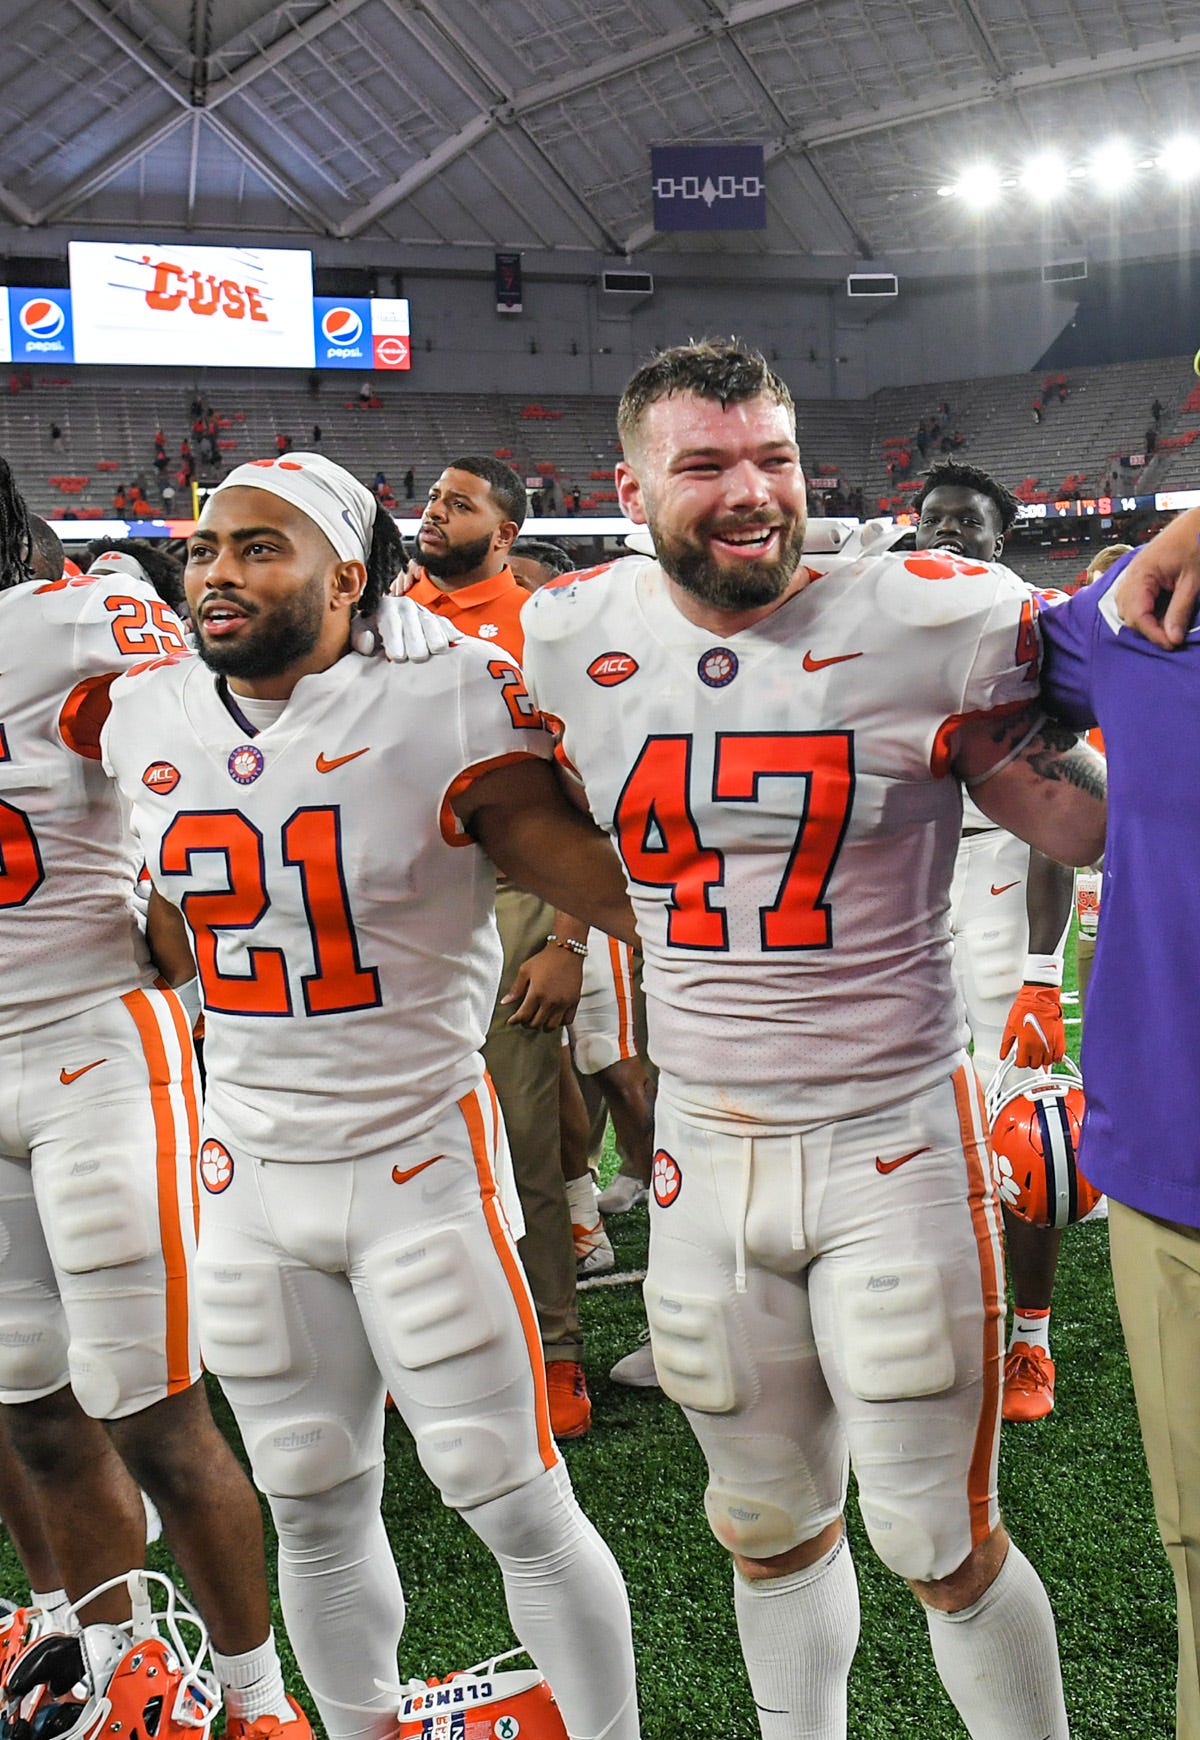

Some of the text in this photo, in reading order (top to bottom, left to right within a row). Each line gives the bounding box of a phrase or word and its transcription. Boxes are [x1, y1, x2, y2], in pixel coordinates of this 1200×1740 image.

[1121, 498, 1136, 511] 14
[104, 595, 190, 655] 25
[1015, 592, 1041, 682] 4
[487, 660, 556, 734] 2
[594, 658, 632, 675] ACC
[147, 766, 174, 783] ACC
[613, 730, 856, 952] 47
[160, 804, 383, 1017] 21
